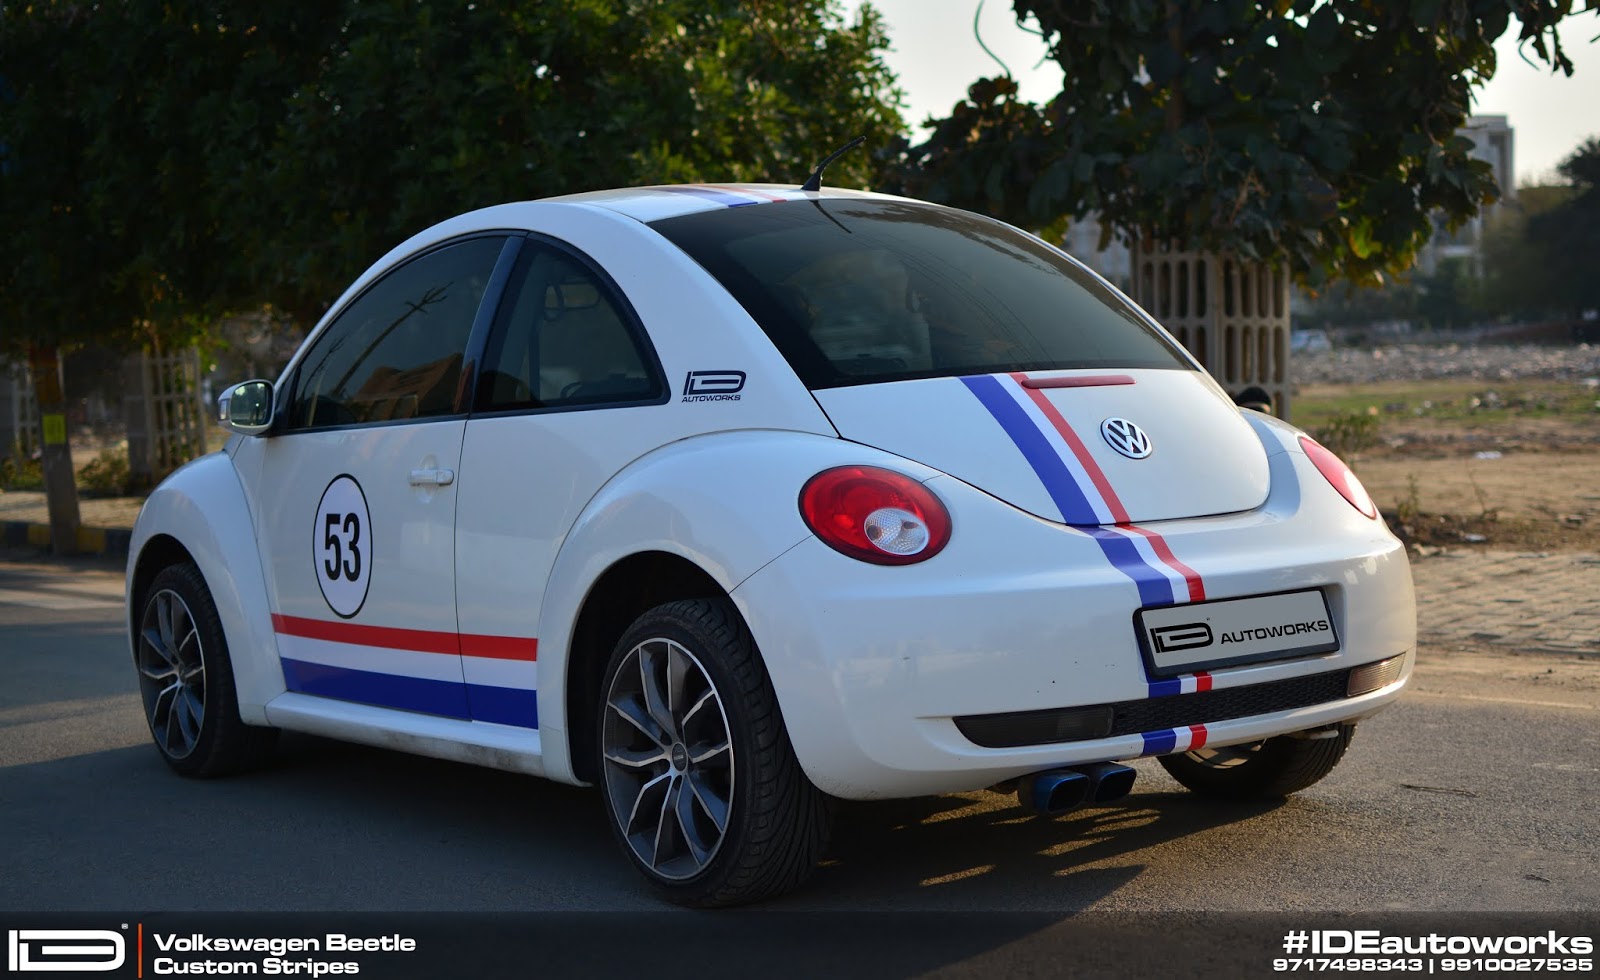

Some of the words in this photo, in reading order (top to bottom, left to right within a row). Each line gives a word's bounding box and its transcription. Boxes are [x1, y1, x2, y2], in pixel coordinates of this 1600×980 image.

[681, 394, 741, 403] AUTOWORKS
[324, 512, 361, 582] 53
[1220, 619, 1329, 645] AUTOWORKS
